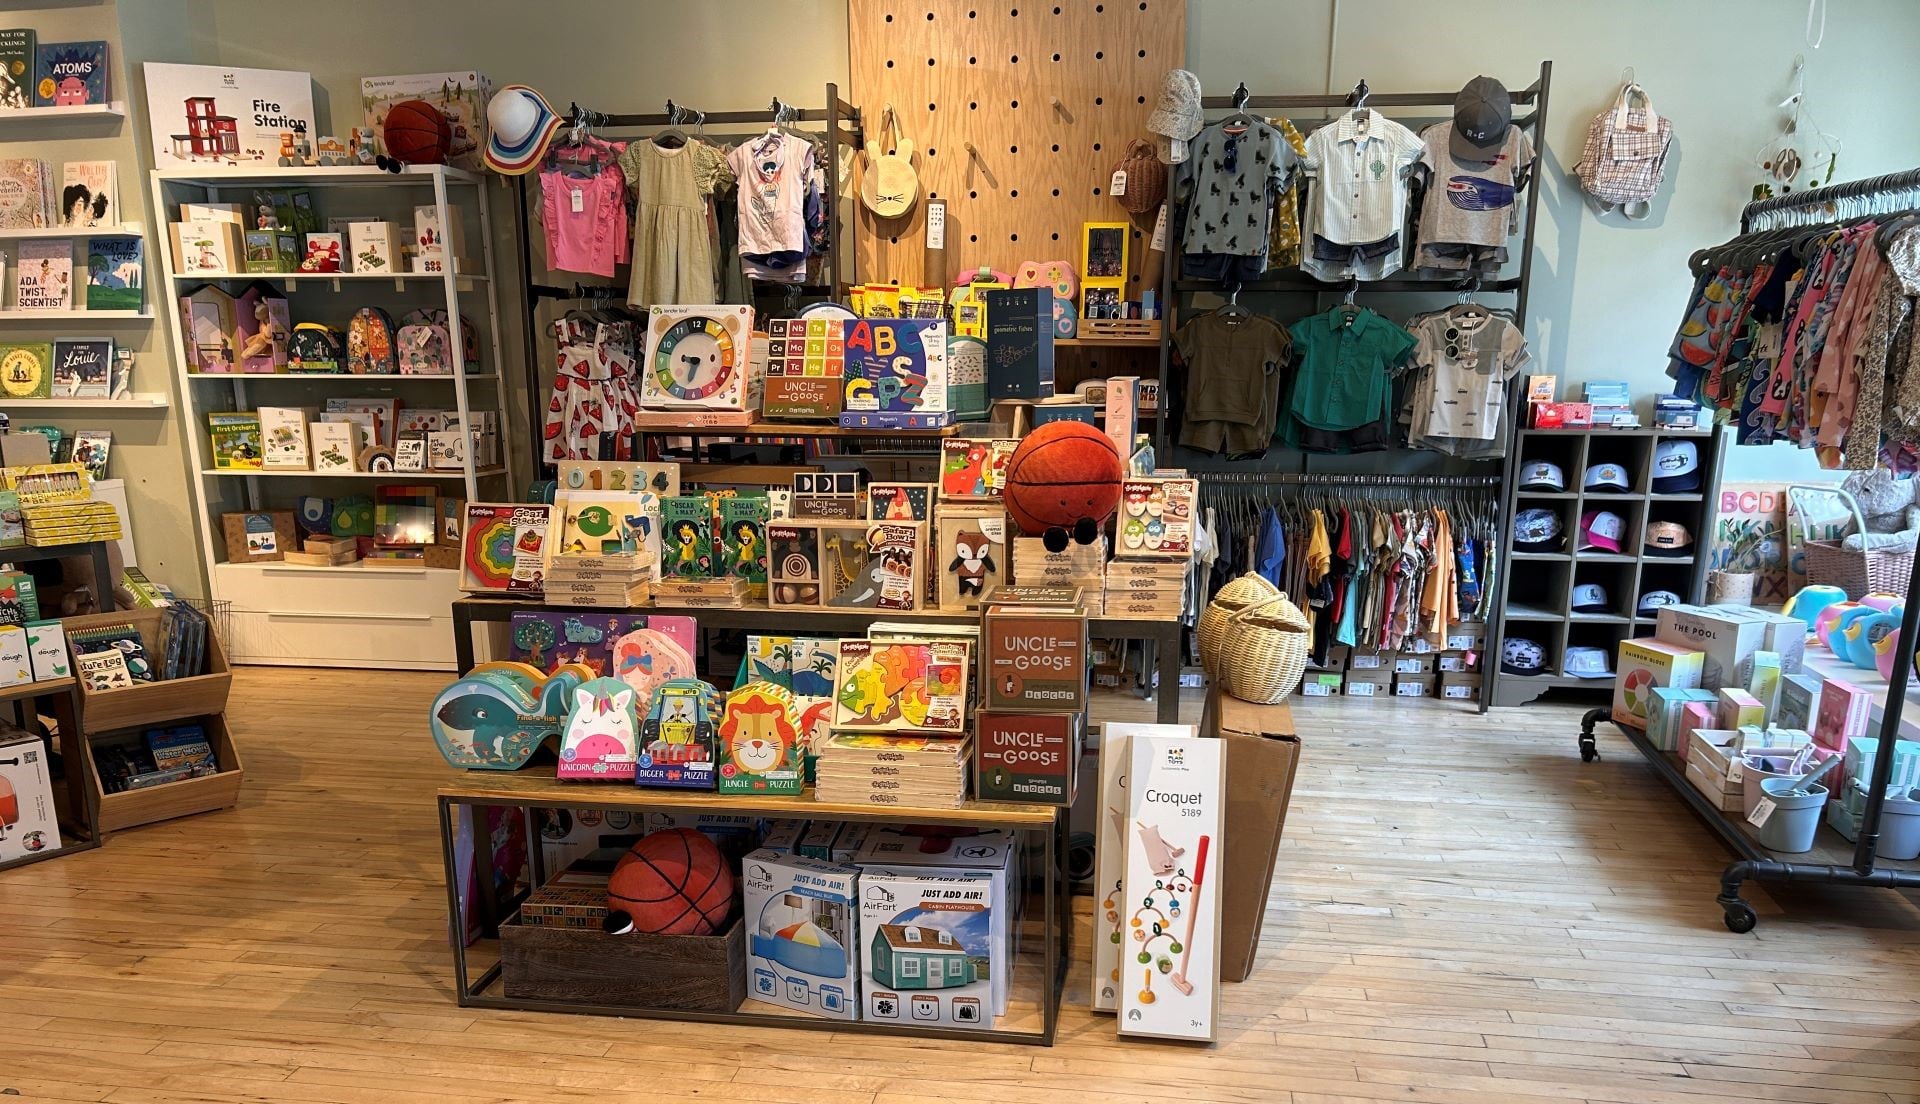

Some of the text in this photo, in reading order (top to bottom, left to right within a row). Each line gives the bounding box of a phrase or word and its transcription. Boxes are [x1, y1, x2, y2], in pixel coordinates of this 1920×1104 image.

[53, 62, 92, 75] ATOMS
[252, 99, 281, 113] Fire
[254, 114, 307, 130] Station
[93, 242, 137, 252] WHAT IS
[112, 251, 138, 262] LOVE?
[20, 276, 38, 286] ADA
[20, 287, 47, 297] TWIST,
[20, 297, 63, 307] SCIENTIST
[692, 320, 701, 328] 12
[773, 325, 784, 333] La
[791, 324, 805, 332] Nb
[812, 325, 823, 333] Te
[675, 327, 684, 335] 11
[790, 344, 803, 352] Mo
[811, 344, 821, 352] Ts
[829, 344, 841, 352] Os
[63, 351, 101, 368] Louie
[927, 354, 943, 362] ABC
[771, 363, 838, 372] Pr Tc He Ir
[784, 381, 816, 391] UNCLE
[790, 392, 824, 402] GOOSE
[861, 416, 868, 425] B
[908, 416, 917, 426] A
[232, 424, 256, 432] Orchard
[804, 500, 829, 508] UNCLE
[514, 509, 544, 517] Gear
[821, 507, 847, 515] GOOSE
[882, 526, 914, 536] Safari
[885, 534, 910, 542] Bowl
[1674, 623, 1717, 640] THE POOL
[1004, 636, 1057, 652] UNCLE
[104, 656, 122, 669] Log
[1014, 655, 1072, 671] GOOSE
[1025, 690, 1075, 700] BLOCKS
[993, 731, 1044, 748] UNCLE
[156, 750, 182, 761] Water
[1003, 750, 1059, 766] GOOSE
[560, 762, 635, 772] UNICORN PUZZLE
[639, 769, 709, 780] DIGGER PUZZLE
[724, 779, 795, 788] JUNGLE PUZZLE
[1013, 784, 1062, 795] BLOCKS
[1146, 789, 1203, 807] Croquet
[1181, 808, 1202, 818] 5189
[698, 814, 716, 823] JUST
[716, 814, 732, 823] ADD
[746, 879, 774, 892] AirFort
[793, 873, 845, 890] JUST ADD AIR!
[921, 889, 983, 900] JUST ADD AIR!
[863, 902, 897, 912] AirFort
